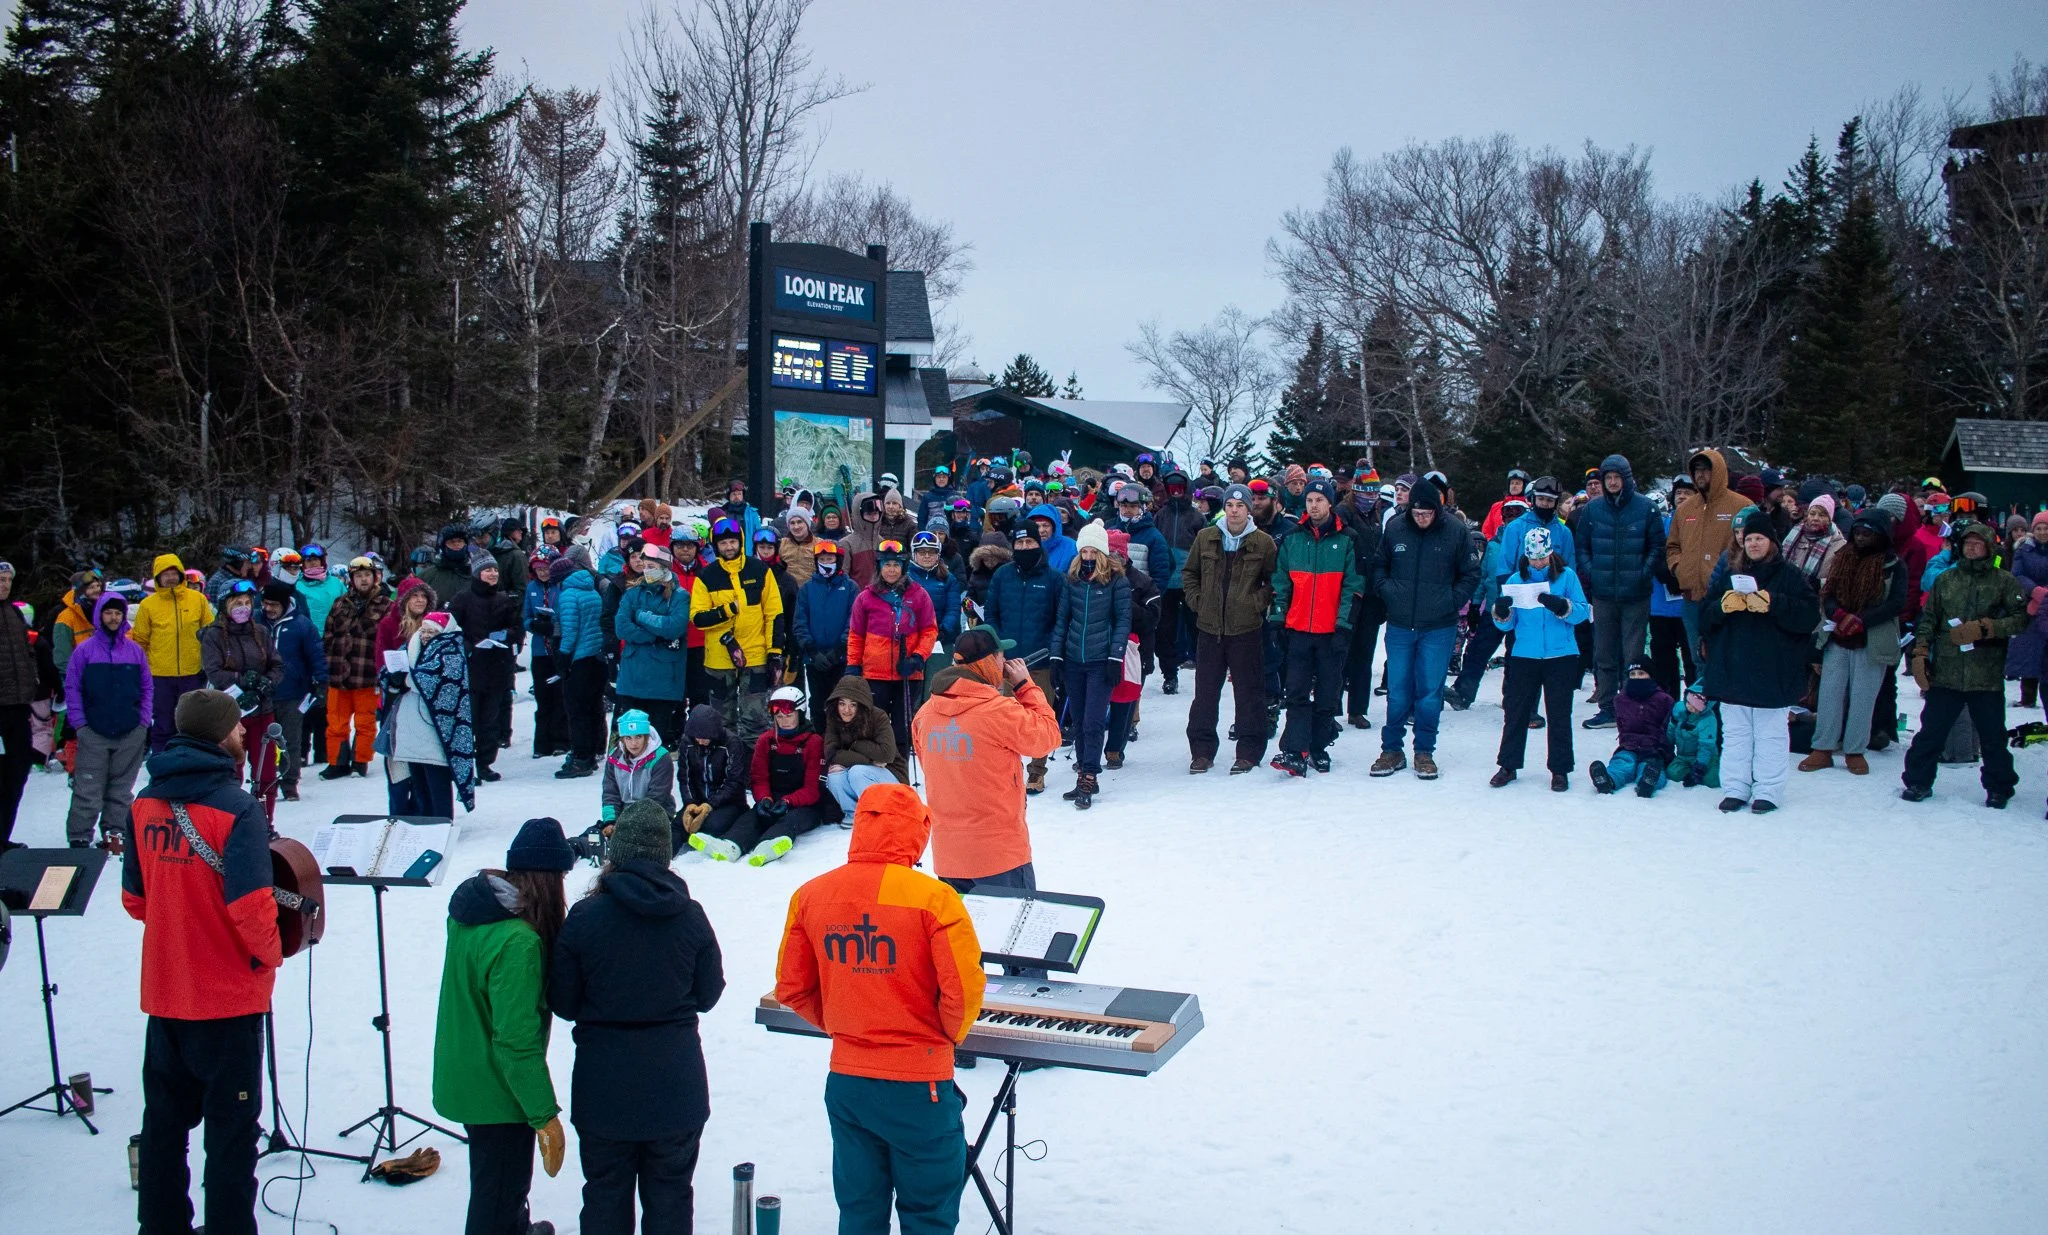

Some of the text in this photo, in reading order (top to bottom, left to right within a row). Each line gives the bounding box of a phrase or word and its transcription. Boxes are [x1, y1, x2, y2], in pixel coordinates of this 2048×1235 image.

[785, 275, 865, 306] LOON PEAK
[807, 301, 832, 309] ELEVATION
[825, 924, 850, 932] LOON
[852, 967, 897, 975] MINISTRY
